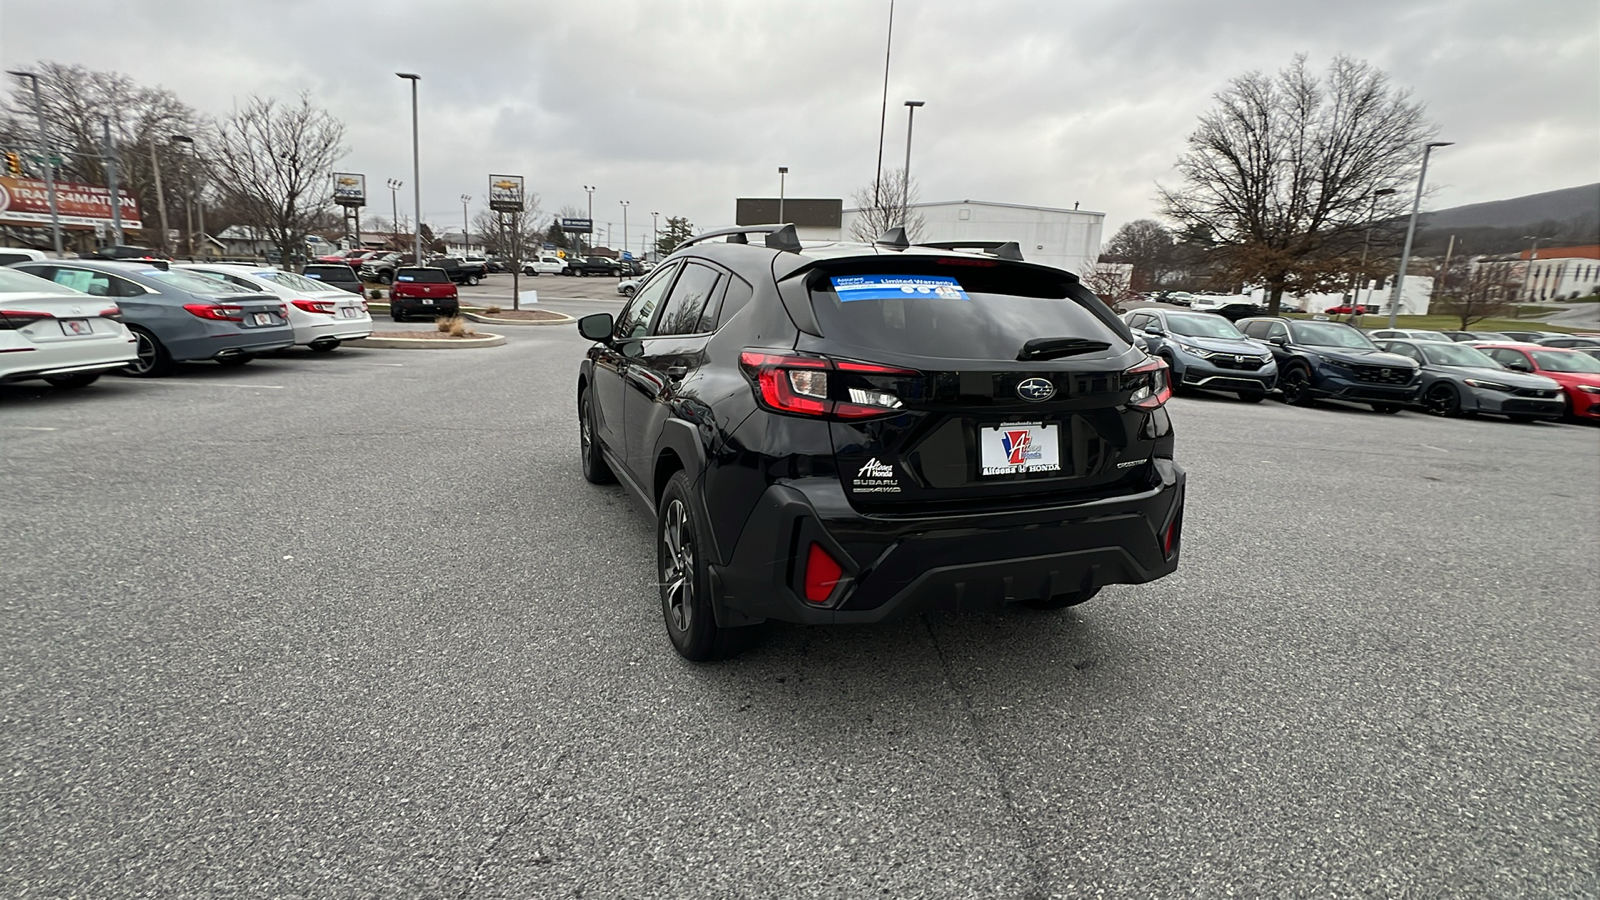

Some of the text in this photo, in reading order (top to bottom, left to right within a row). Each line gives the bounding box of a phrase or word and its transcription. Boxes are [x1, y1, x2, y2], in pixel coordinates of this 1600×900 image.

[914, 278, 954, 287] Warranty
[983, 466, 1017, 476] Altoona
[1028, 463, 1061, 473] HONDA
